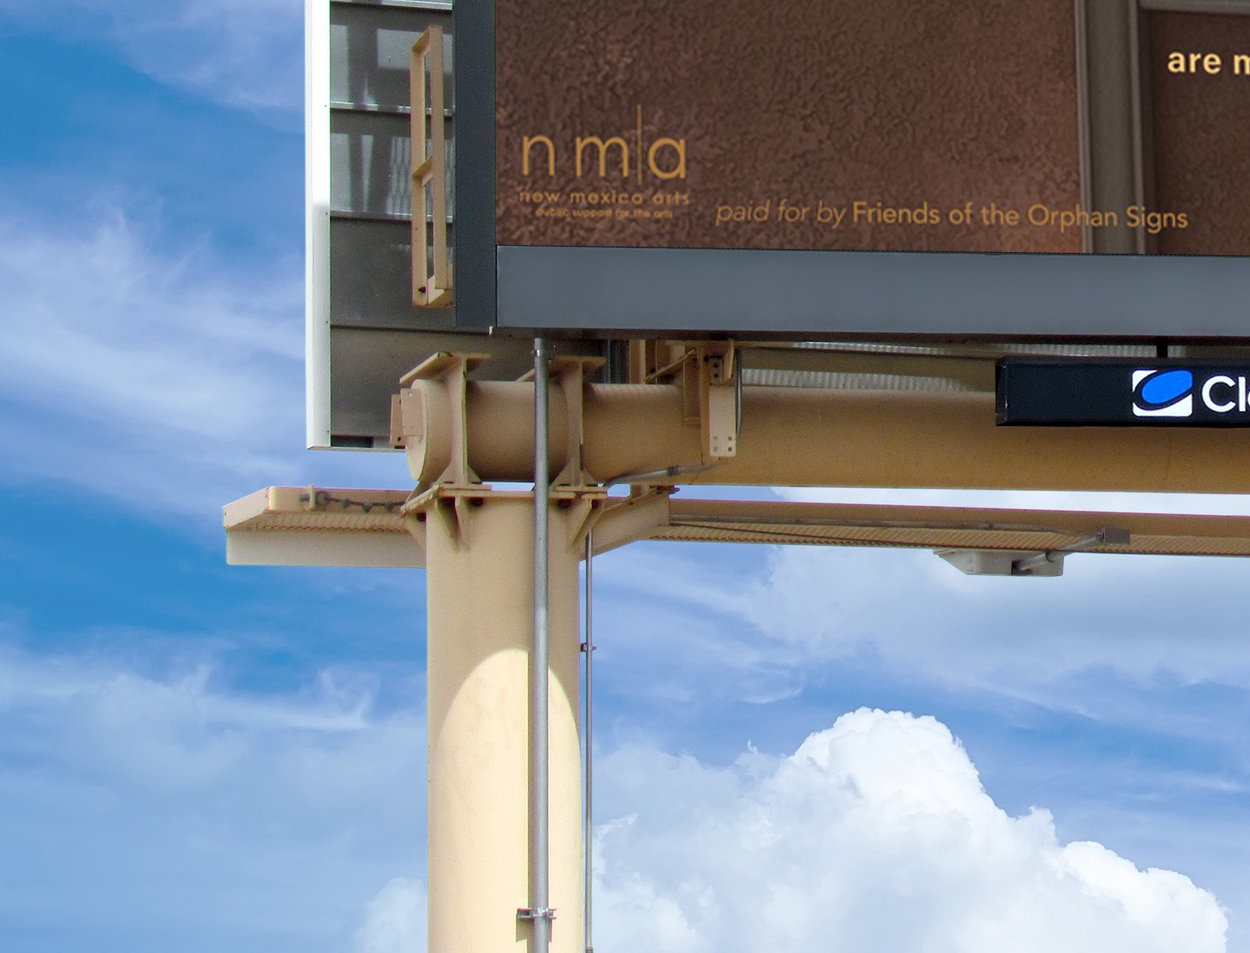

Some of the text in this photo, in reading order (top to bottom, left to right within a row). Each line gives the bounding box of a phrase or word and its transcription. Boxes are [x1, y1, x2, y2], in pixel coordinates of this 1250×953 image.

[1167, 51, 1222, 74] are
[651, 191, 690, 206] arts
[715, 199, 1189, 234] paid for by Friends of the Orphan Signs
